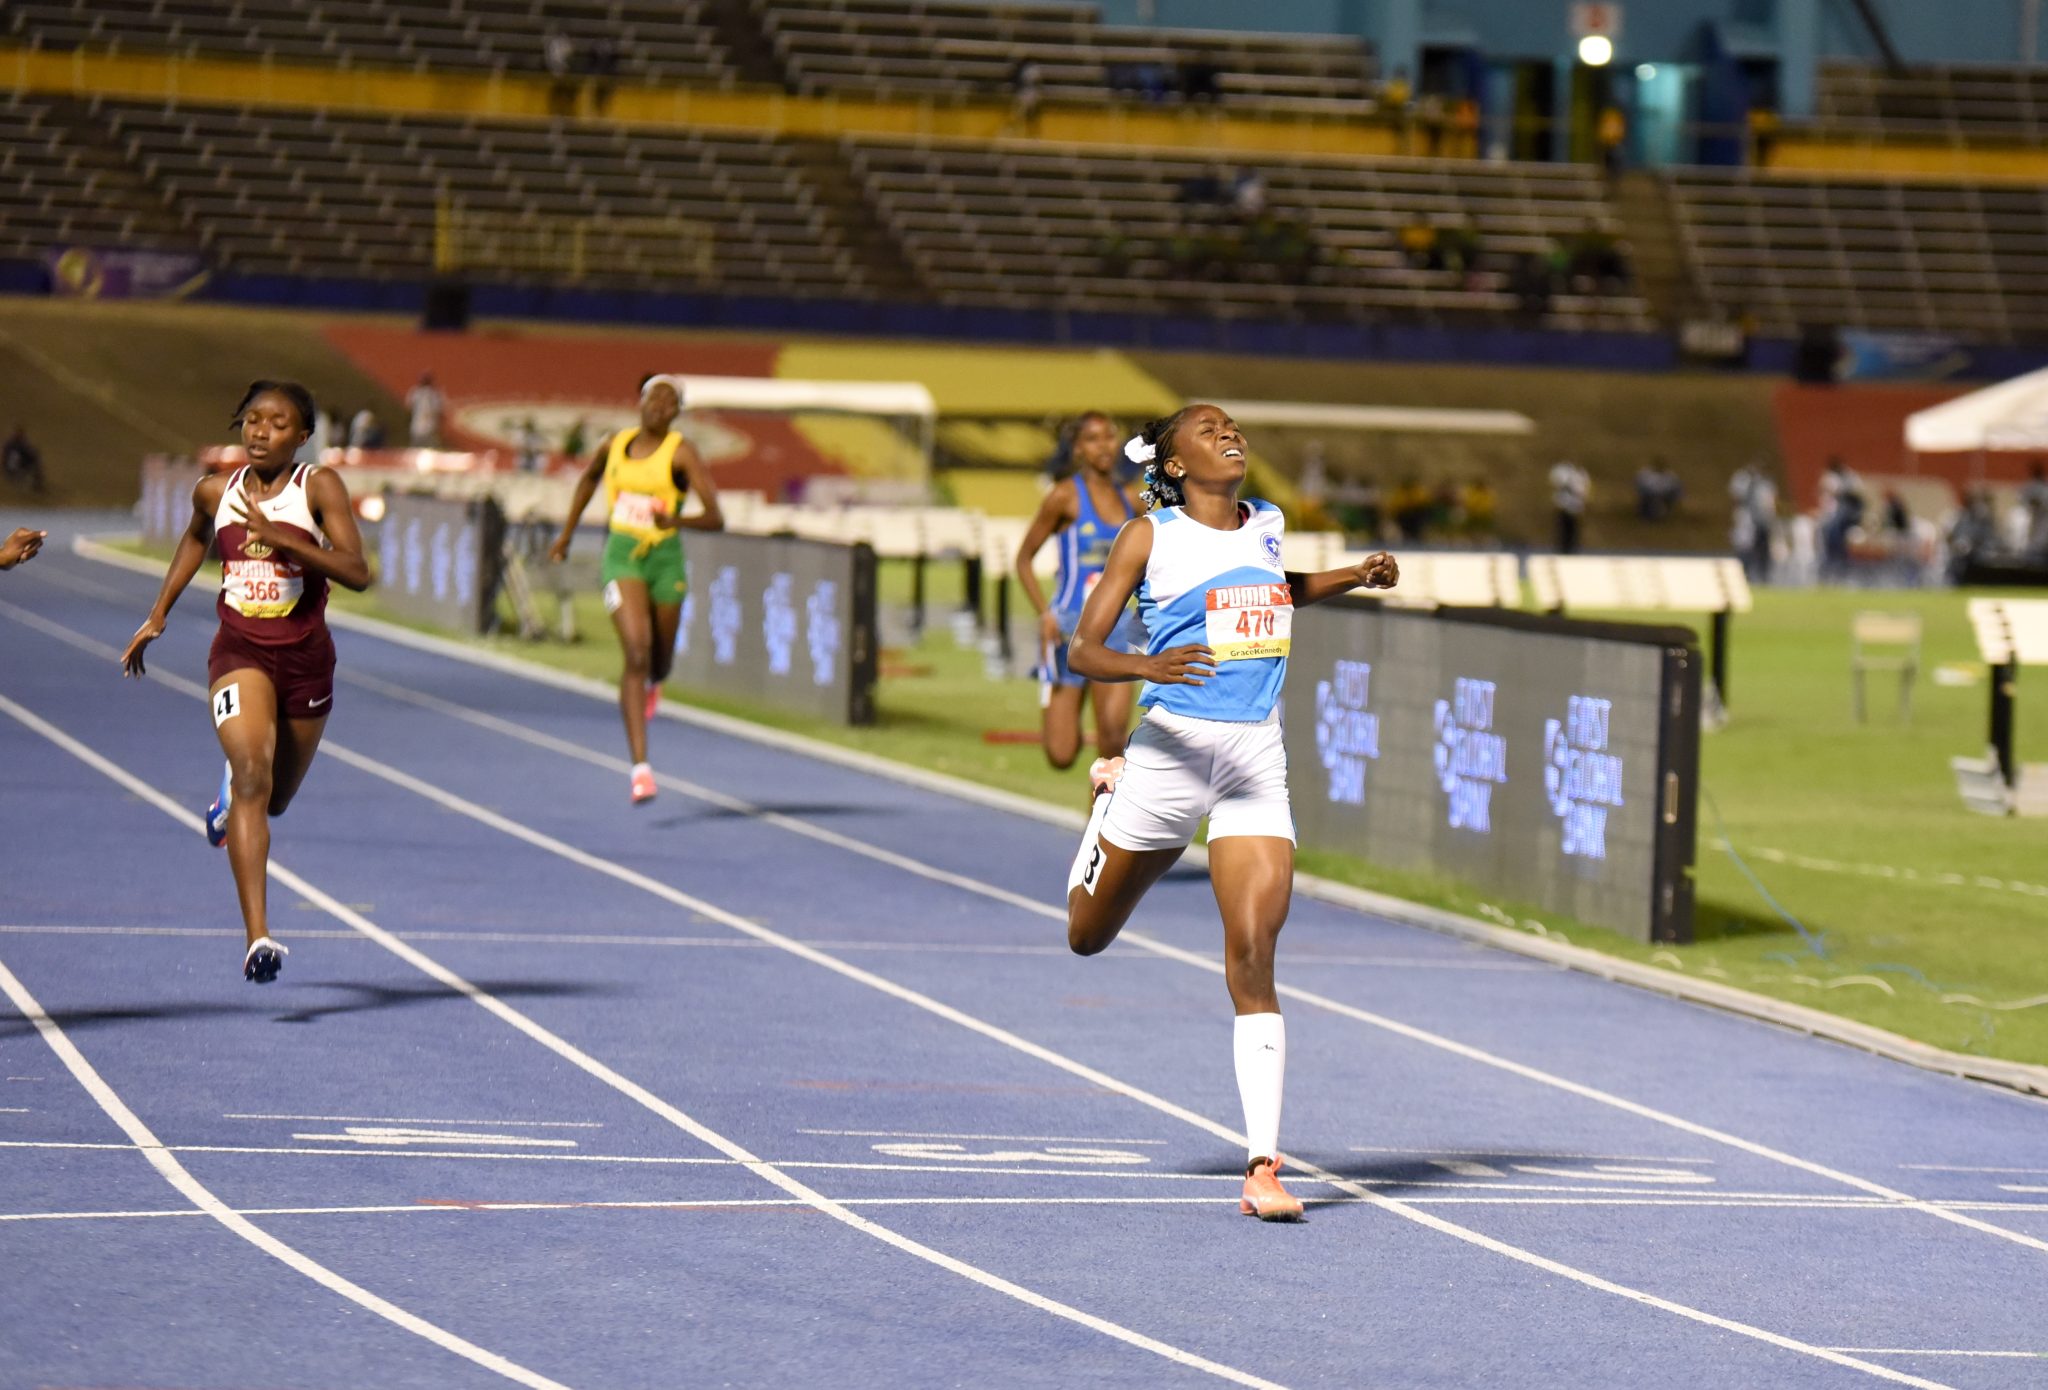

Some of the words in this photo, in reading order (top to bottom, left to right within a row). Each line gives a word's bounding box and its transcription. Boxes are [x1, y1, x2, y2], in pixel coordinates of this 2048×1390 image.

[244, 580, 280, 601] 366
[1215, 585, 1271, 609] PUMA
[1236, 610, 1275, 638] 470
[1230, 647, 1282, 657] GraceKennedy
[217, 688, 234, 716] 4
[1085, 844, 1100, 885] 3
